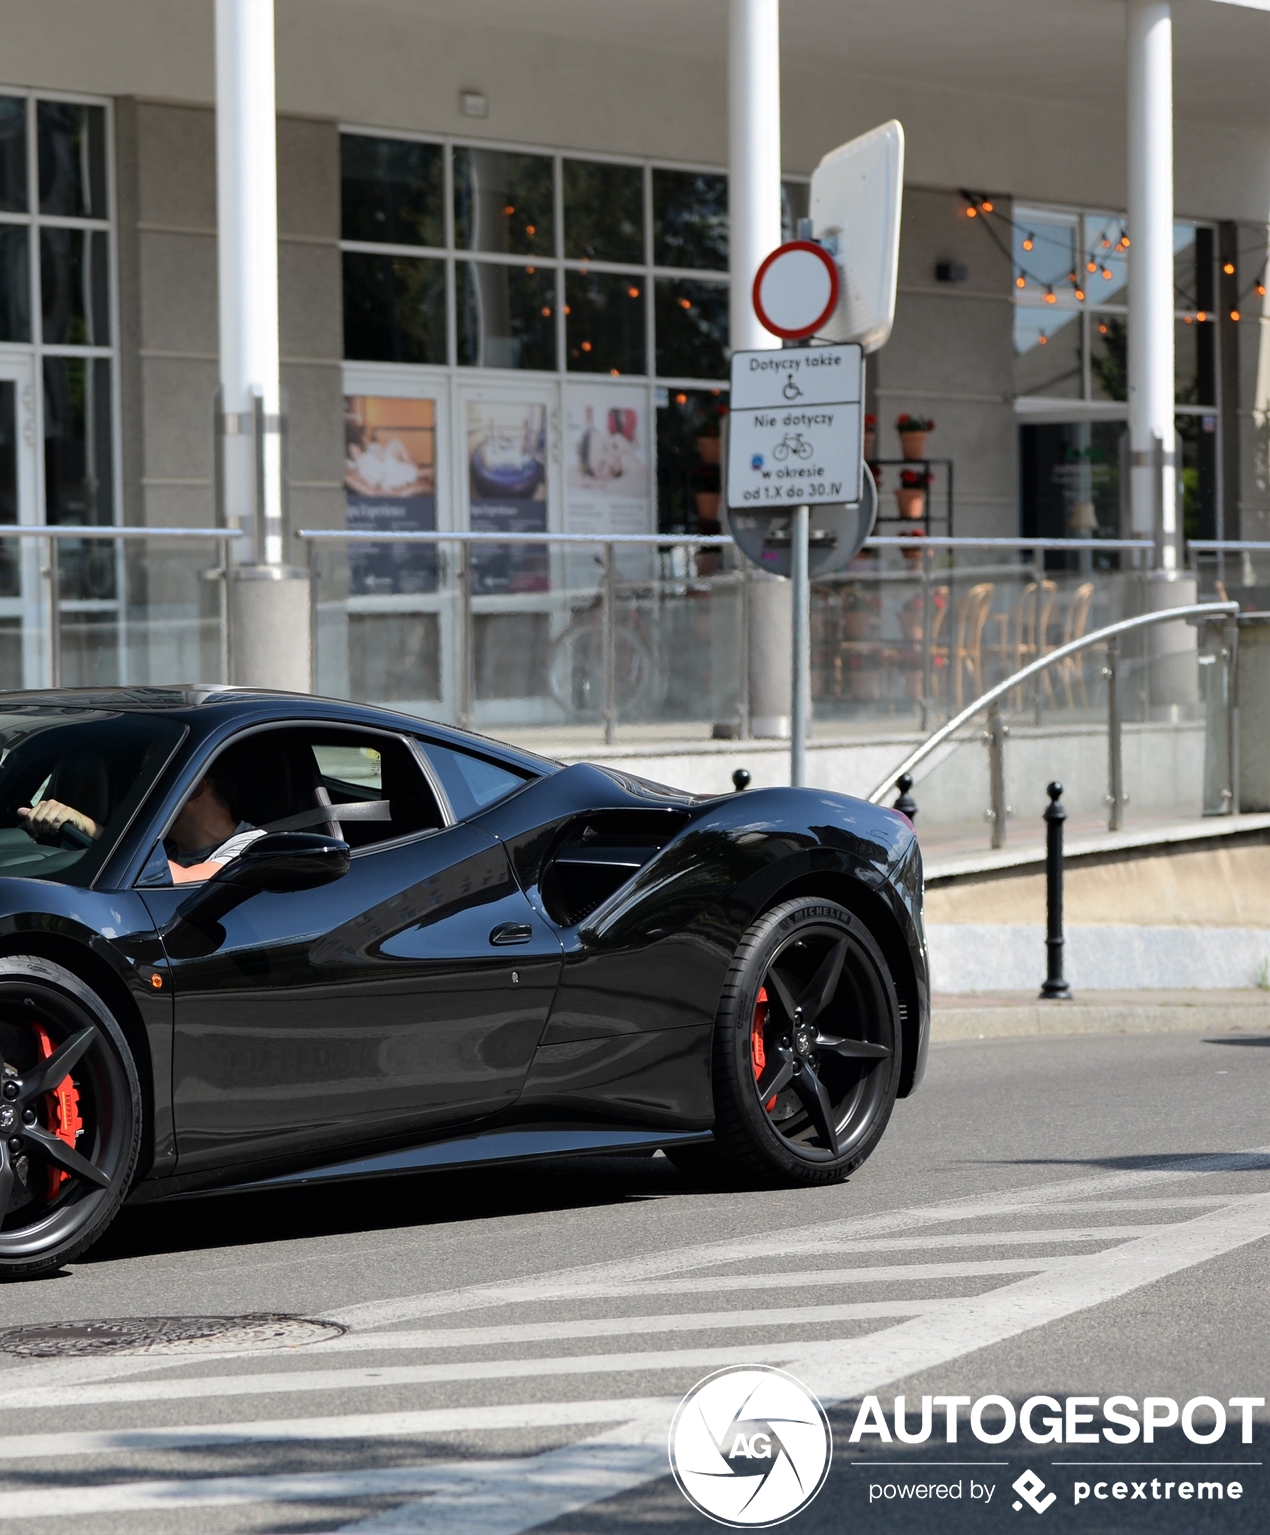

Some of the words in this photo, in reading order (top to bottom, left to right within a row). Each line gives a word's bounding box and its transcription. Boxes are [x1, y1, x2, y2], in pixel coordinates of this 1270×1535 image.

[750, 358, 801, 373] Dotyczy
[805, 353, 842, 367] także
[754, 415, 777, 427] Nie
[783, 413, 834, 429] dotyczy
[762, 469, 771, 479] w
[776, 465, 825, 479] okresie
[743, 487, 761, 500] od
[765, 487, 782, 499] 1.X
[787, 484, 804, 497] do
[809, 482, 842, 496] 30.IV
[794, 906, 849, 922] MICHELIN
[65, 1094, 73, 1127] Ferrari
[793, 1164, 850, 1181] MICHELIN
